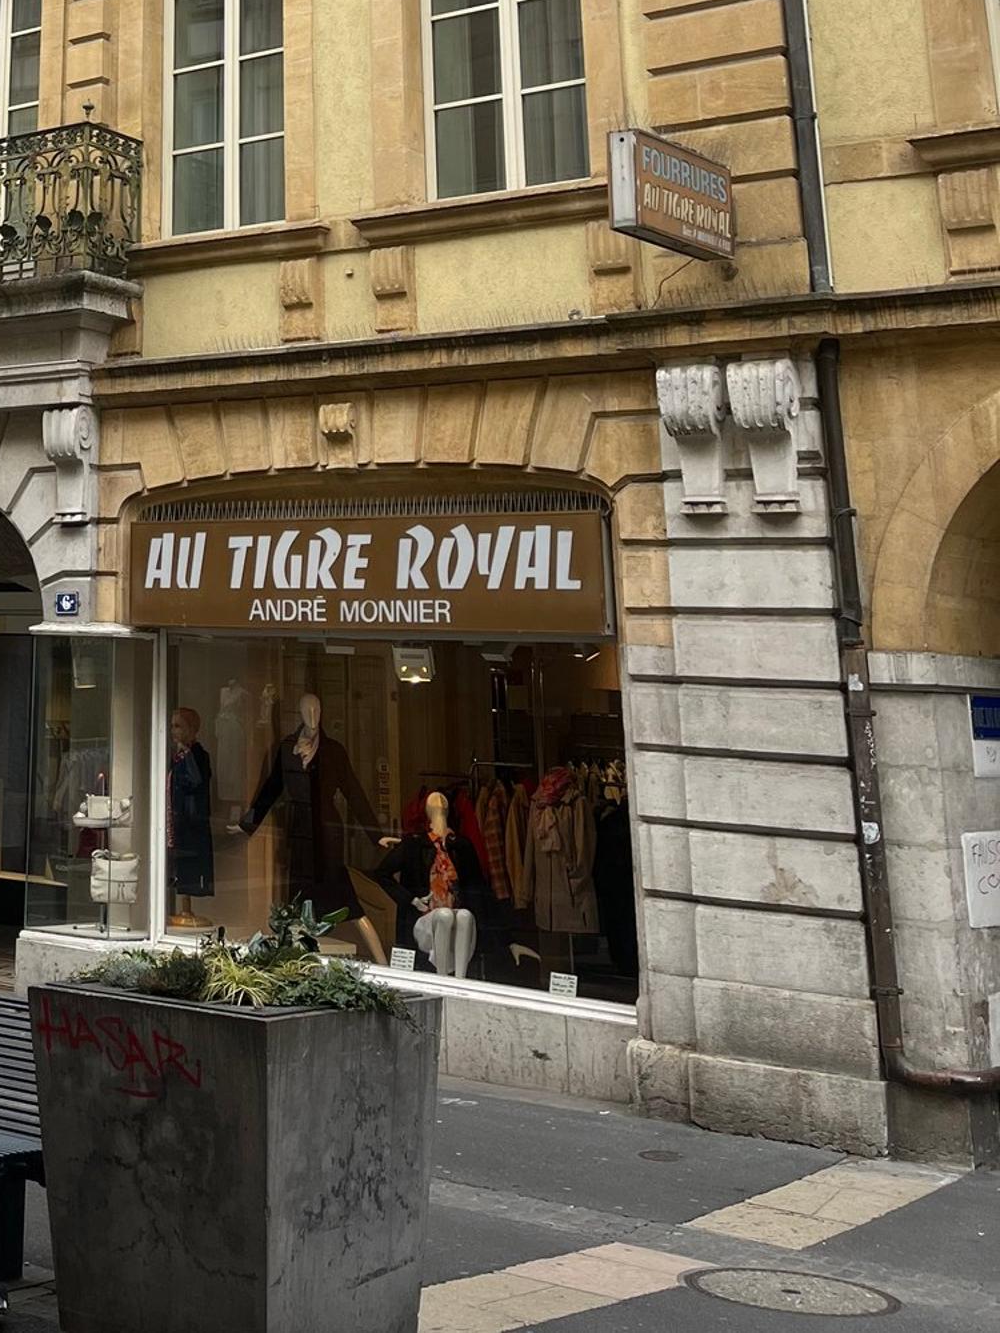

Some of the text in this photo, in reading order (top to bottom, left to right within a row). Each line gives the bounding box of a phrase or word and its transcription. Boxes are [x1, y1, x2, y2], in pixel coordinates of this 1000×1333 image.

[642, 145, 728, 204] FOURRURES
[643, 182, 660, 212] AU
[662, 188, 695, 225] TIGRE
[696, 203, 731, 238] ROYAL
[144, 523, 582, 590] AU TIGRE ROYAL
[249, 595, 452, 623] ANDRÉ MONNIER
